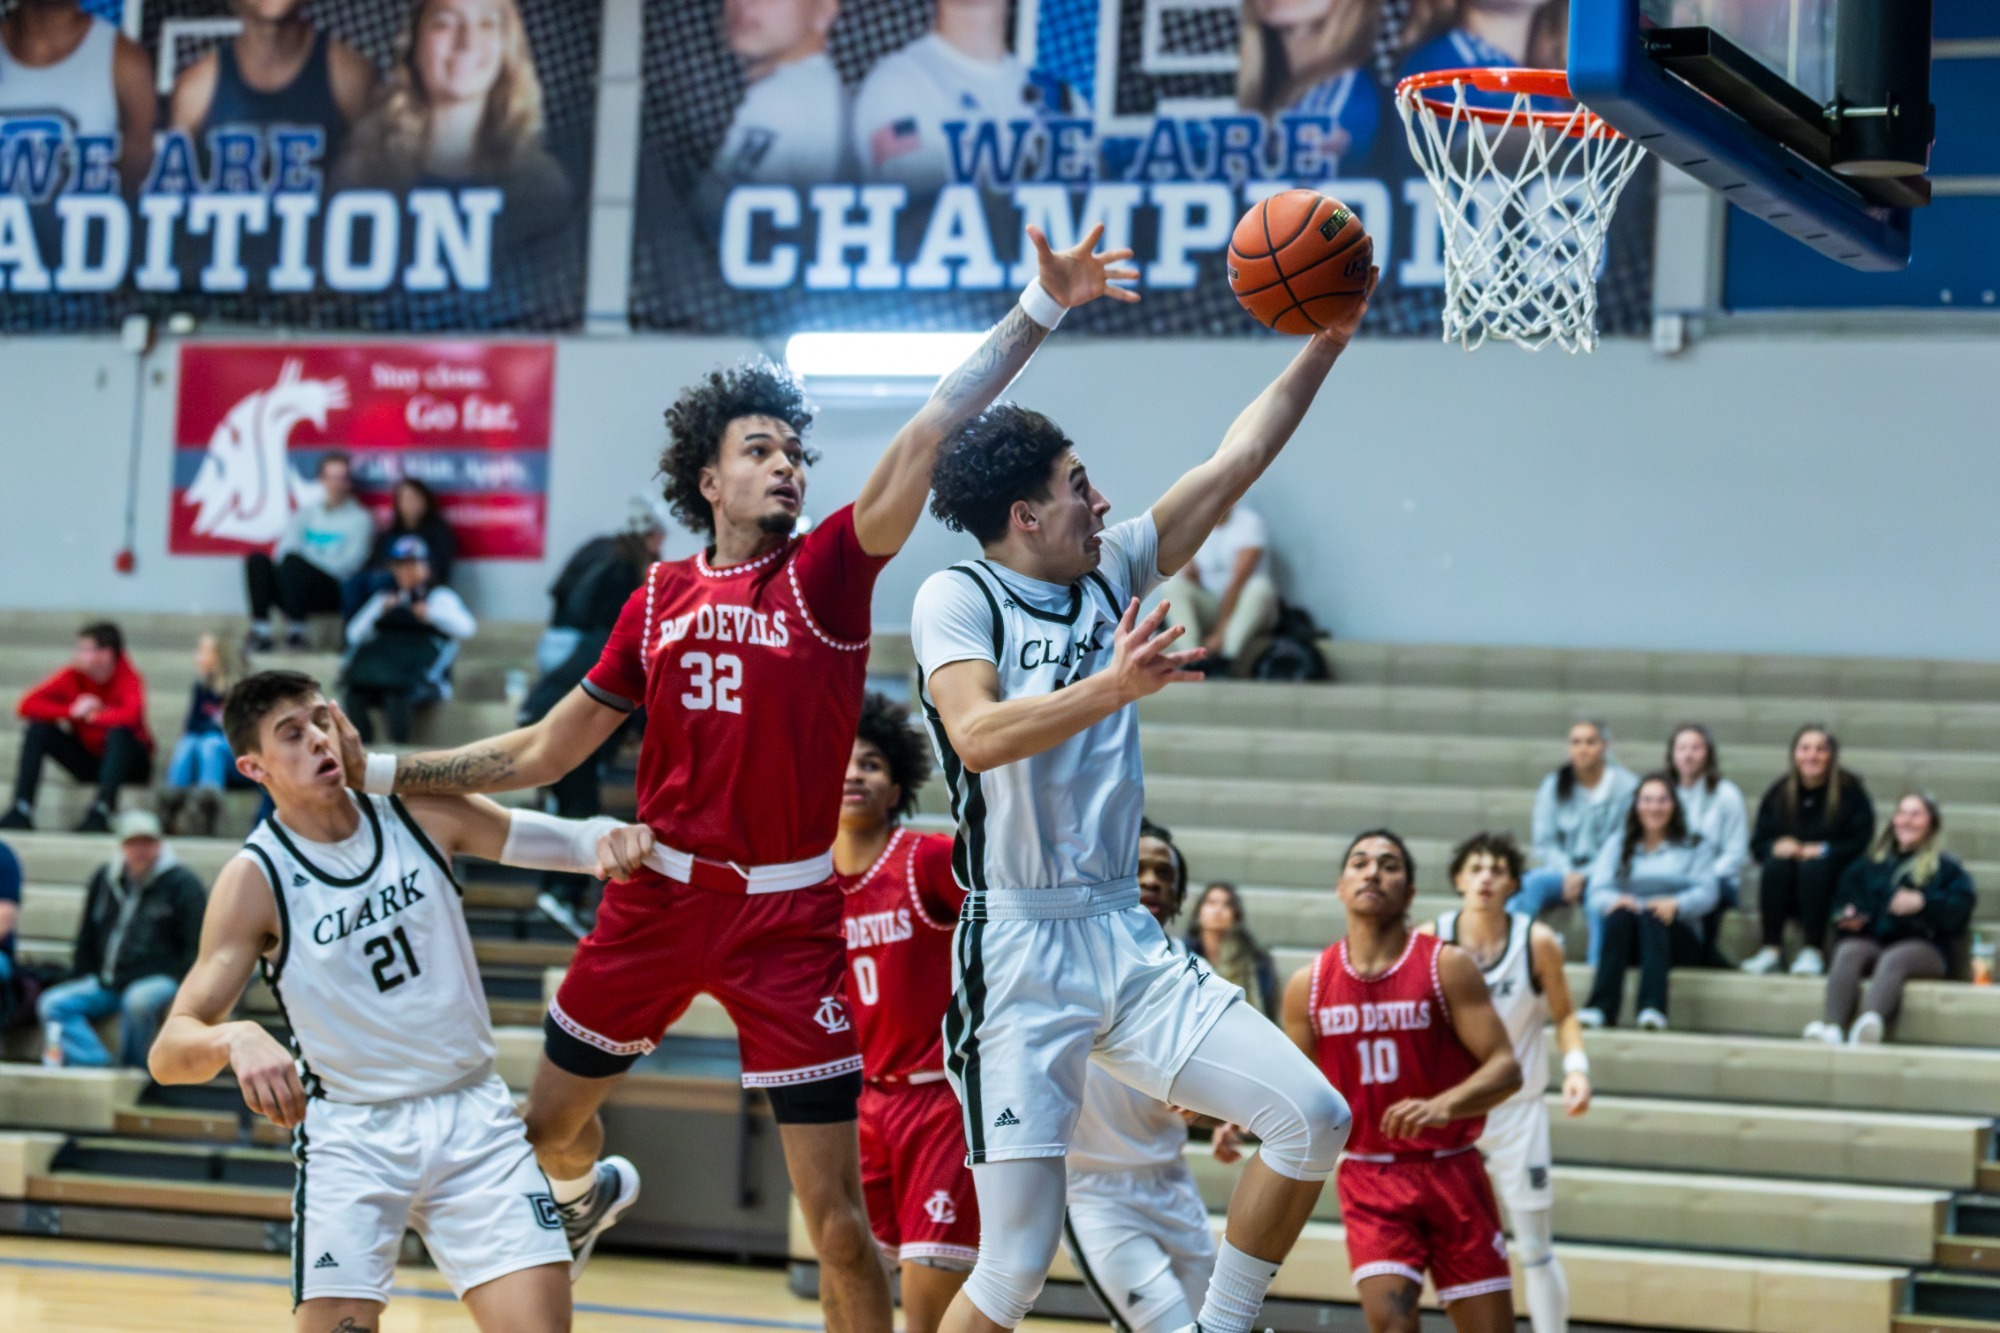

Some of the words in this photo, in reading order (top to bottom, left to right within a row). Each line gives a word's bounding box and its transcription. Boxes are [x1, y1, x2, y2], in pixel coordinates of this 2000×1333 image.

[0, 134, 121, 197] WE
[144, 125, 324, 197] ARE
[940, 117, 1096, 187] WE
[1130, 114, 1337, 185] ARE
[0, 187, 505, 293] ADITION
[719, 179, 1607, 292] CHAMPNS
[695, 603, 790, 648] DEVILS
[680, 651, 743, 714] 32
[312, 868, 427, 946] CLARK
[844, 908, 914, 950] DEVILS
[363, 924, 421, 994] 21
[1318, 1004, 1359, 1037] RED
[1360, 1000, 1431, 1033] DEVILS
[1356, 1037, 1399, 1086] 10
